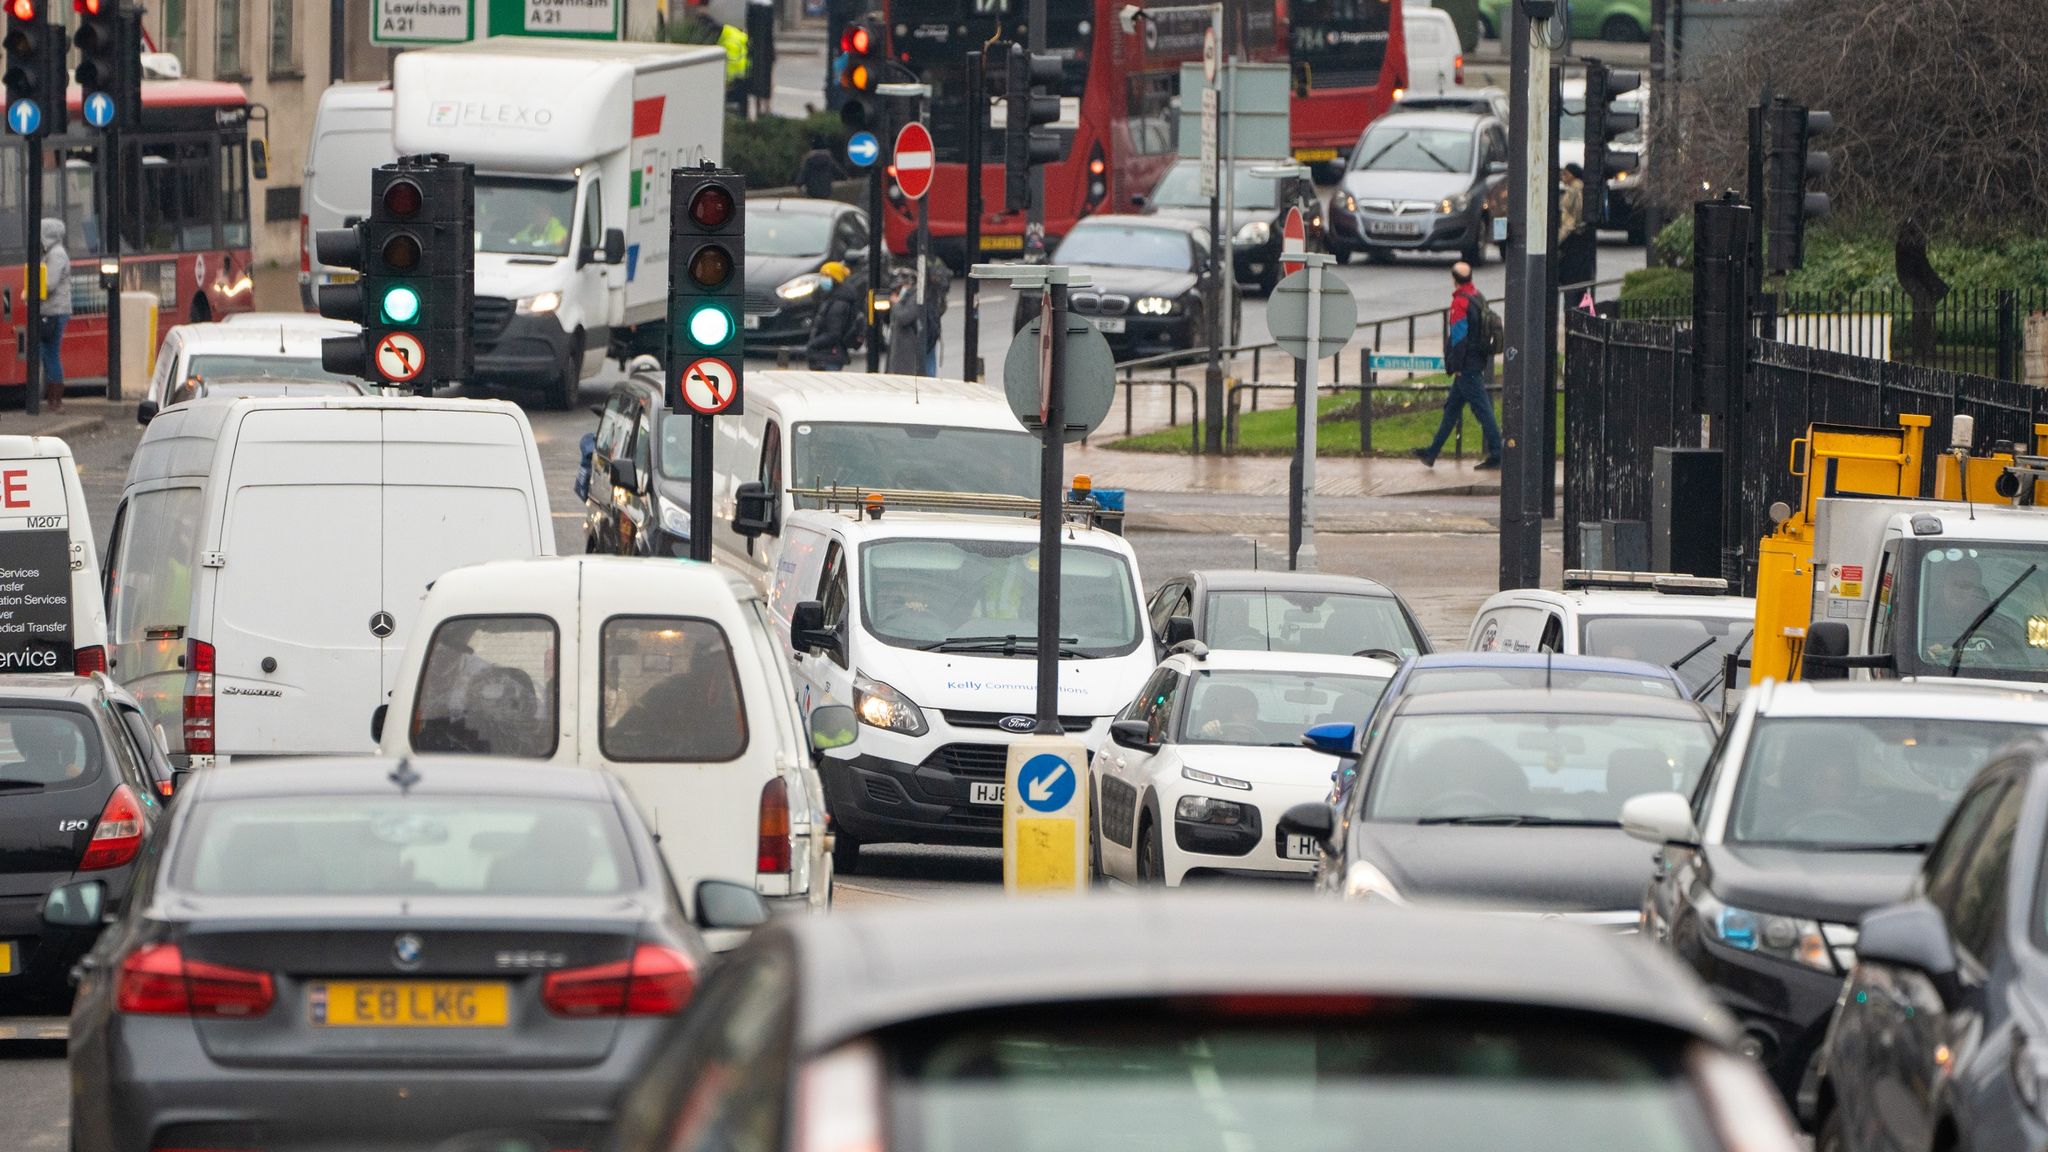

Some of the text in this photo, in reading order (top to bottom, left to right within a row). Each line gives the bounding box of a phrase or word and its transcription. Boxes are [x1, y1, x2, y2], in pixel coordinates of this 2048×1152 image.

[384, 3, 461, 16] Lewisham
[464, 102, 551, 125] FLEXO
[1374, 357, 1433, 369] Canadian
[0, 469, 31, 508] E
[27, 516, 62, 528] M207
[24, 594, 67, 605] Services
[27, 621, 67, 632] Transfer
[947, 681, 1088, 695] Kelly Commutions
[1008, 717, 1031, 729] Ford
[59, 819, 89, 832] i20
[408, 983, 477, 1021] LKG
